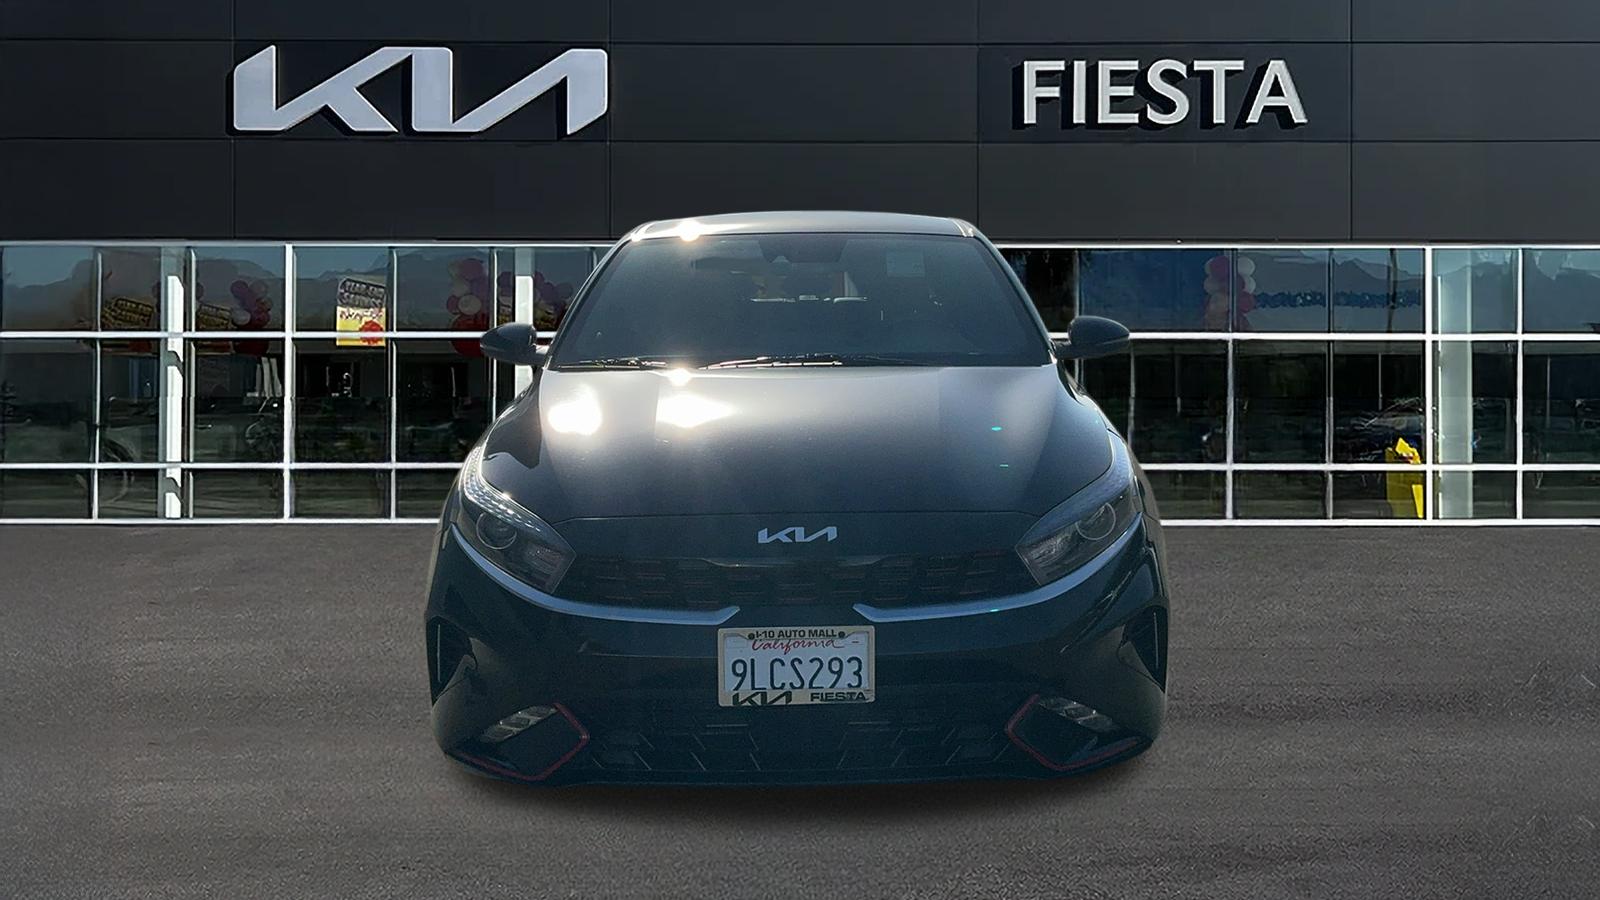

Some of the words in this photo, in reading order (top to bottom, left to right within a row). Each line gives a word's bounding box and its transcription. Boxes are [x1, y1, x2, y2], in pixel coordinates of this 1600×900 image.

[233, 45, 608, 135] KIA
[1023, 58, 1308, 124] FIESTA
[758, 526, 837, 543] KIA
[756, 631, 775, 639] I-10
[777, 630, 806, 638] AUTO
[810, 629, 837, 638] MALL
[752, 639, 845, 655] California
[731, 657, 863, 691] 9LCS293
[733, 691, 793, 706] KIA
[810, 692, 866, 702] FIESTA
